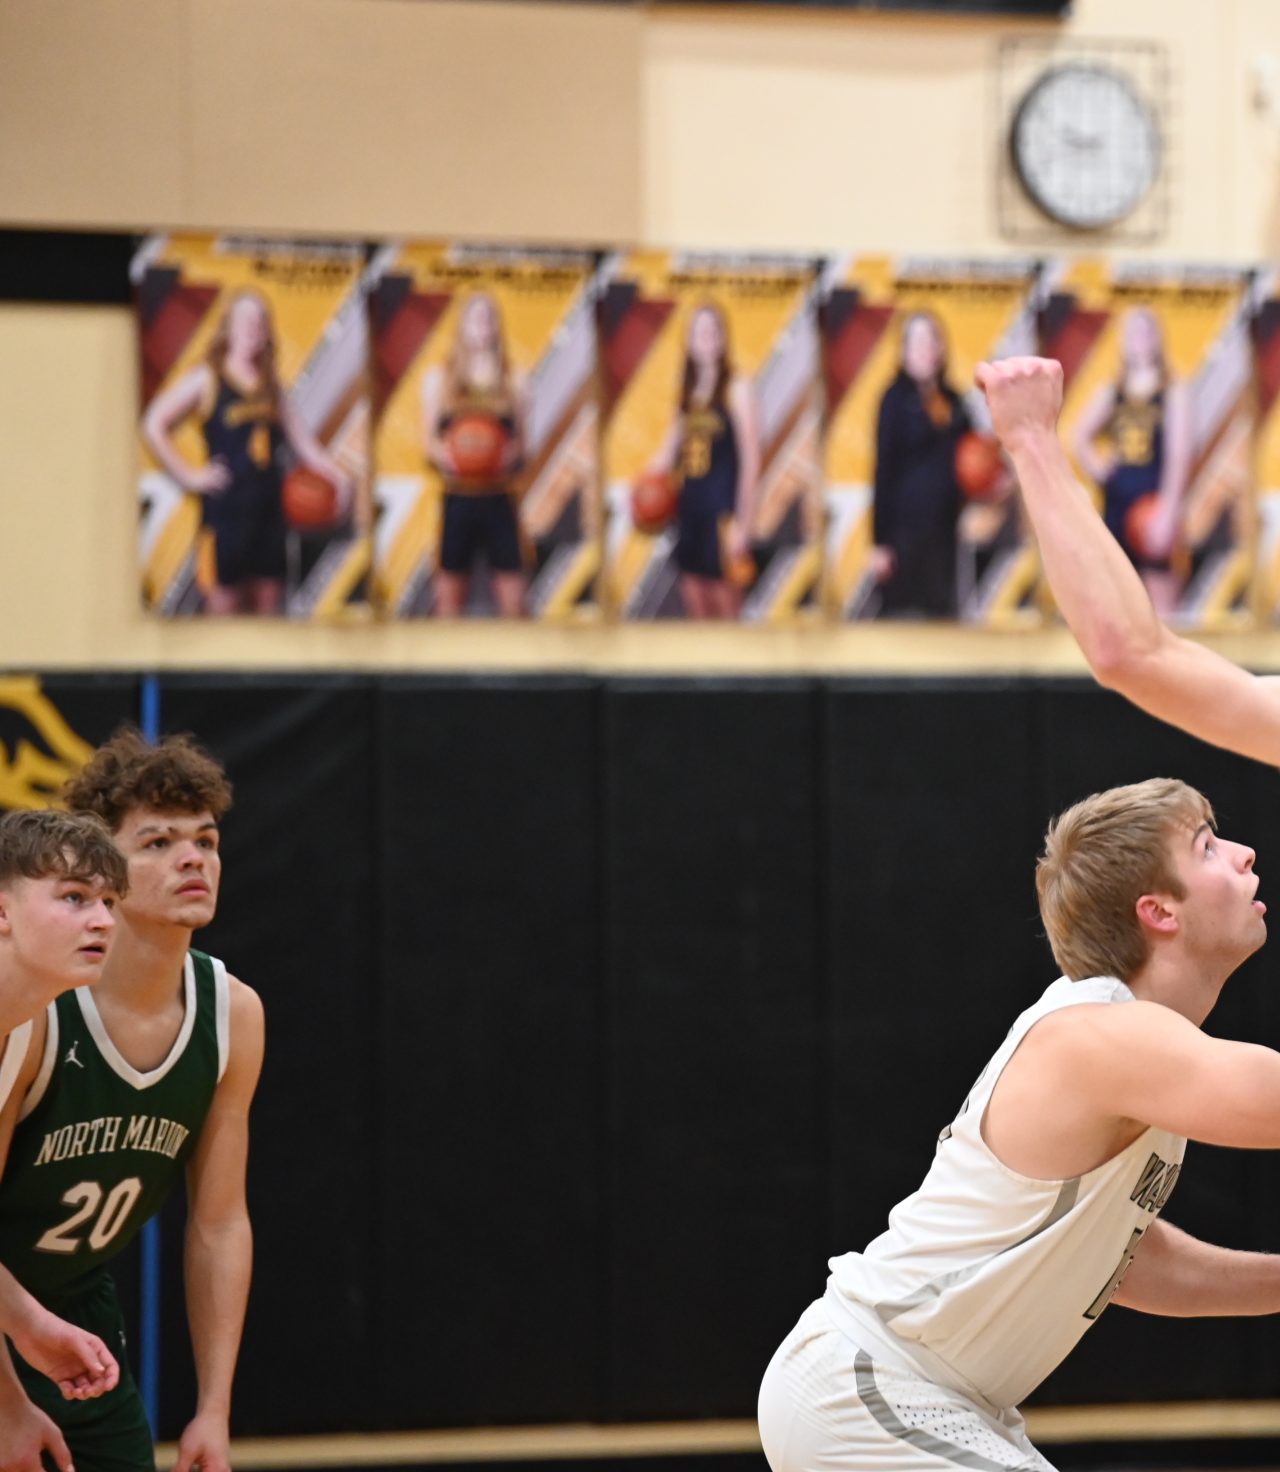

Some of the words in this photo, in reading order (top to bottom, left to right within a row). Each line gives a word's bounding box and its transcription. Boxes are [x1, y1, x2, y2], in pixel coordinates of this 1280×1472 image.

[33, 1116, 123, 1166] NORTH
[120, 1114, 190, 1160] MARION
[35, 1176, 143, 1253] 20
